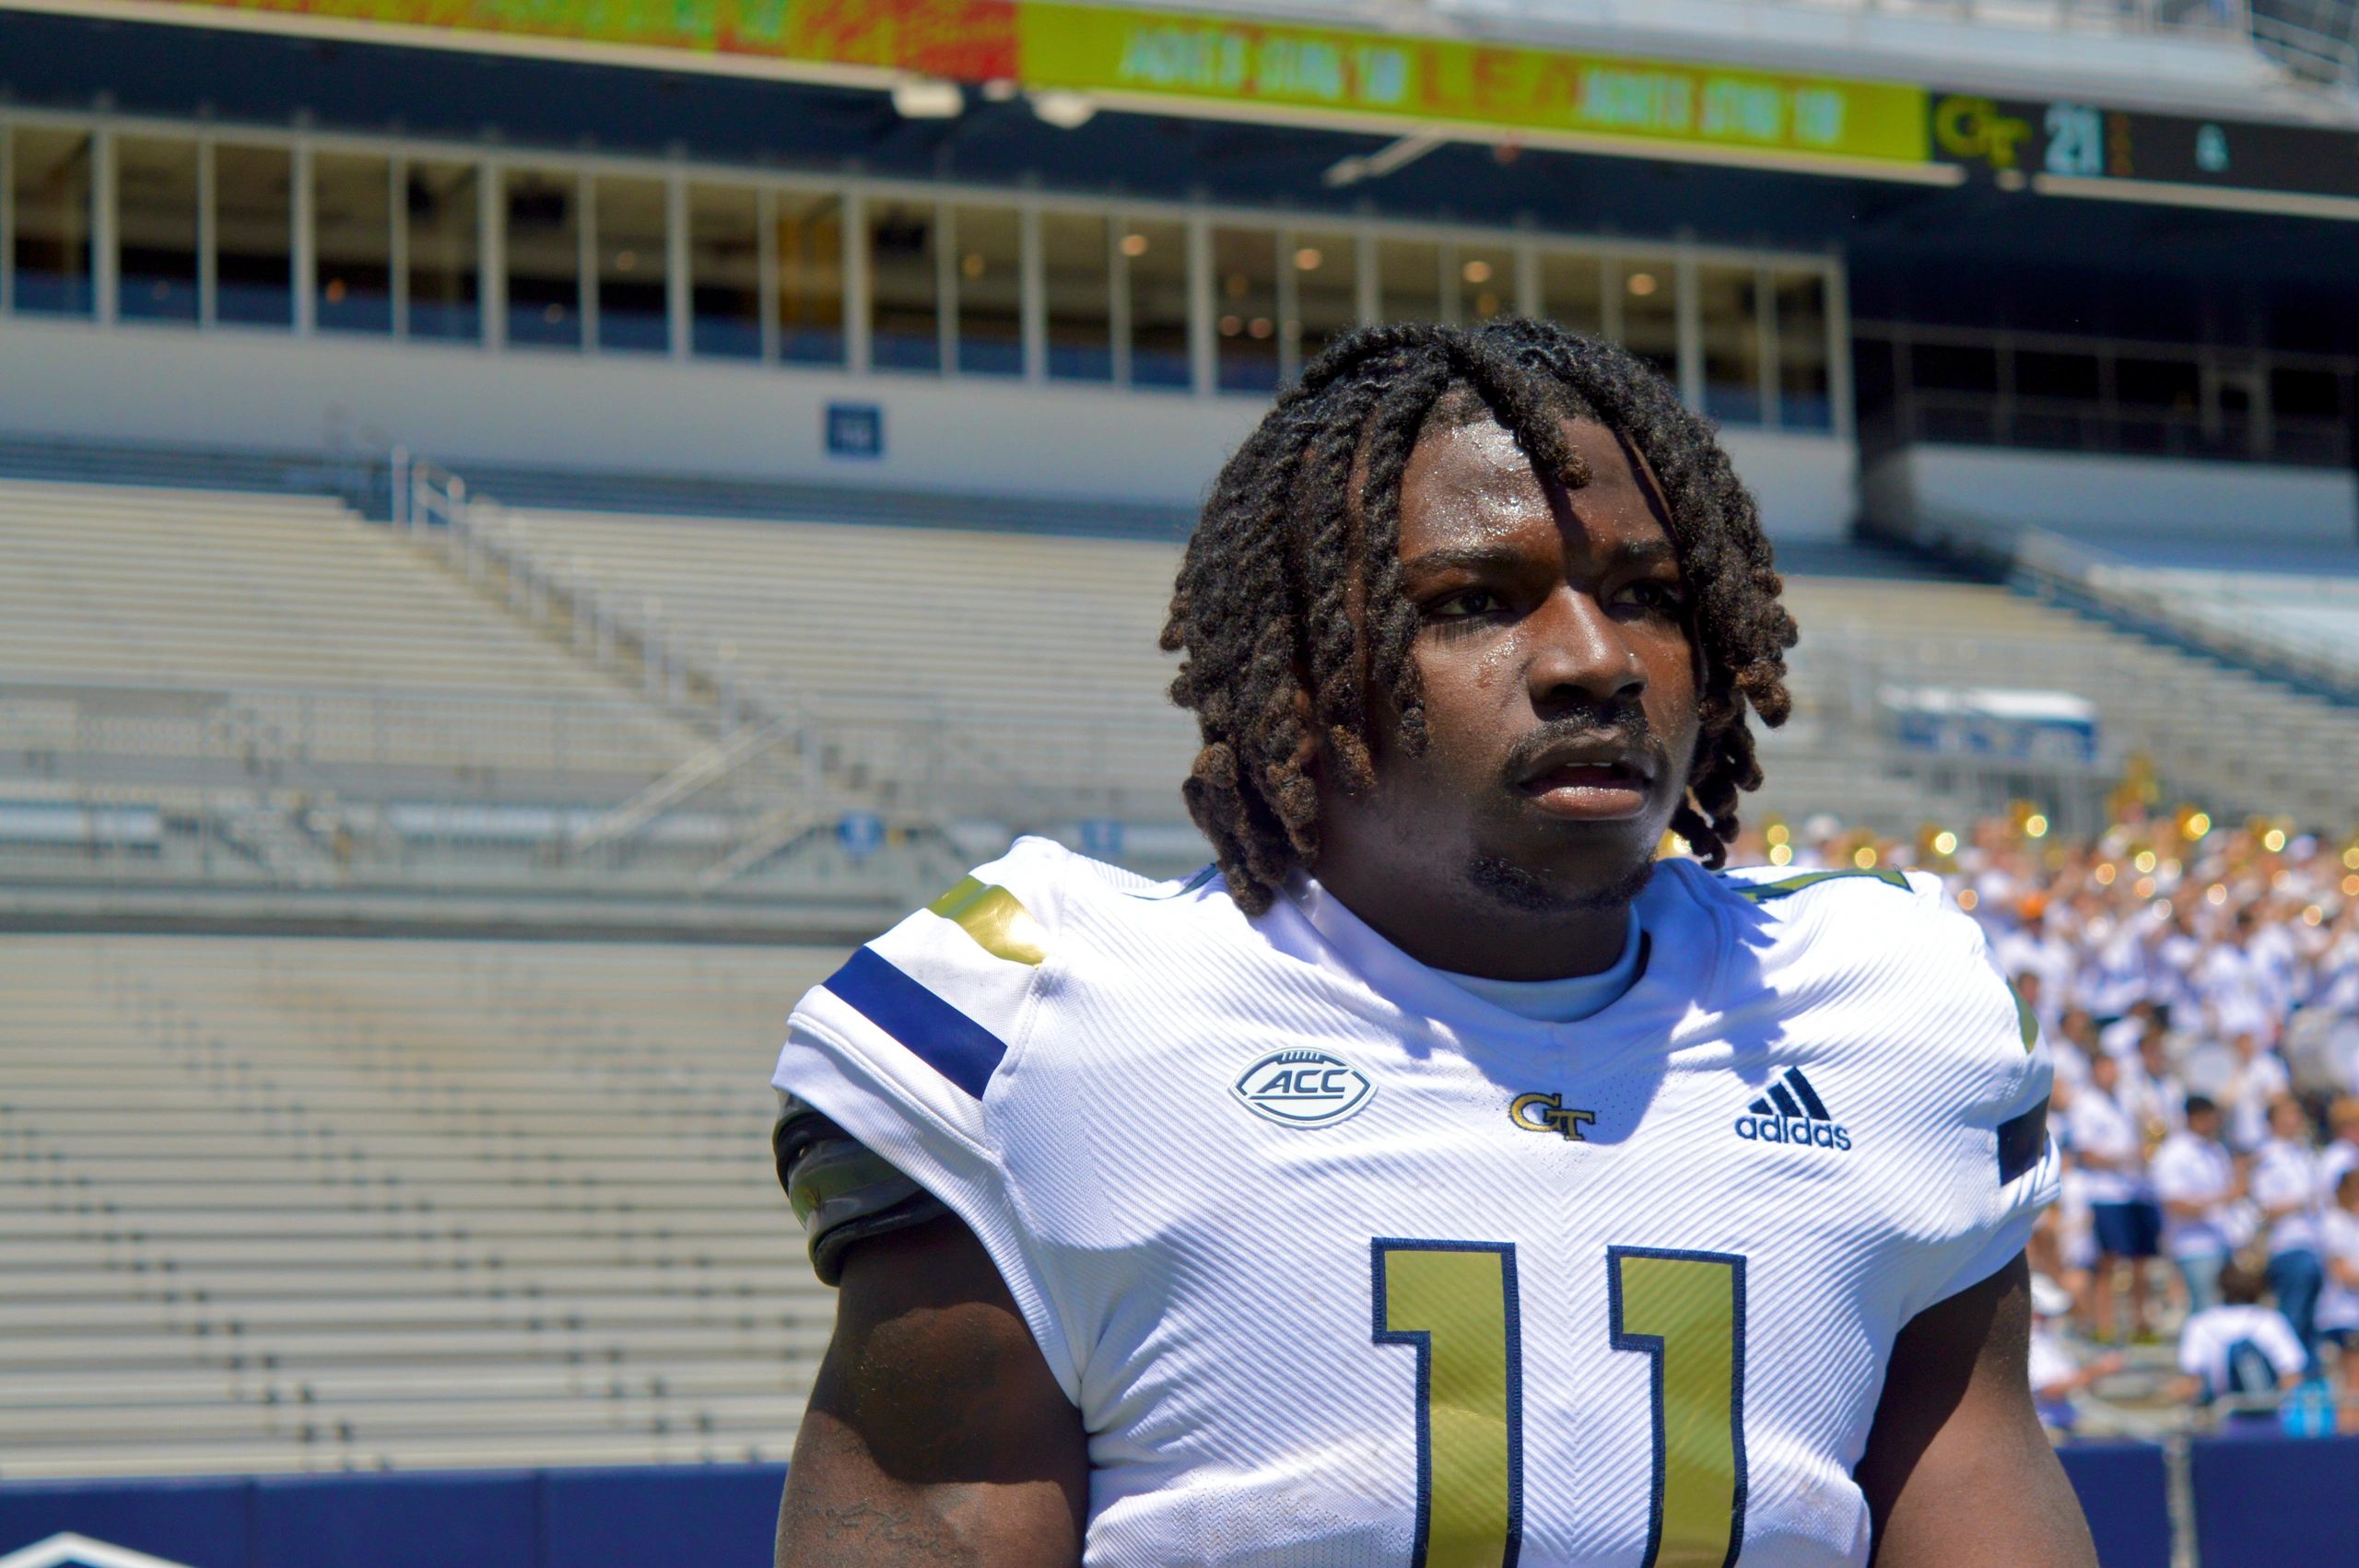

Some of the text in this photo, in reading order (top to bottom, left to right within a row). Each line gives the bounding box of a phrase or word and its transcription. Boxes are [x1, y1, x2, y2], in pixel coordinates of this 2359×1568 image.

[1256, 1070, 1349, 1094] ACC
[1509, 1093, 1596, 1141] GT
[1734, 1114, 1852, 1152] adidas
[1371, 1236, 1748, 1568] 11
